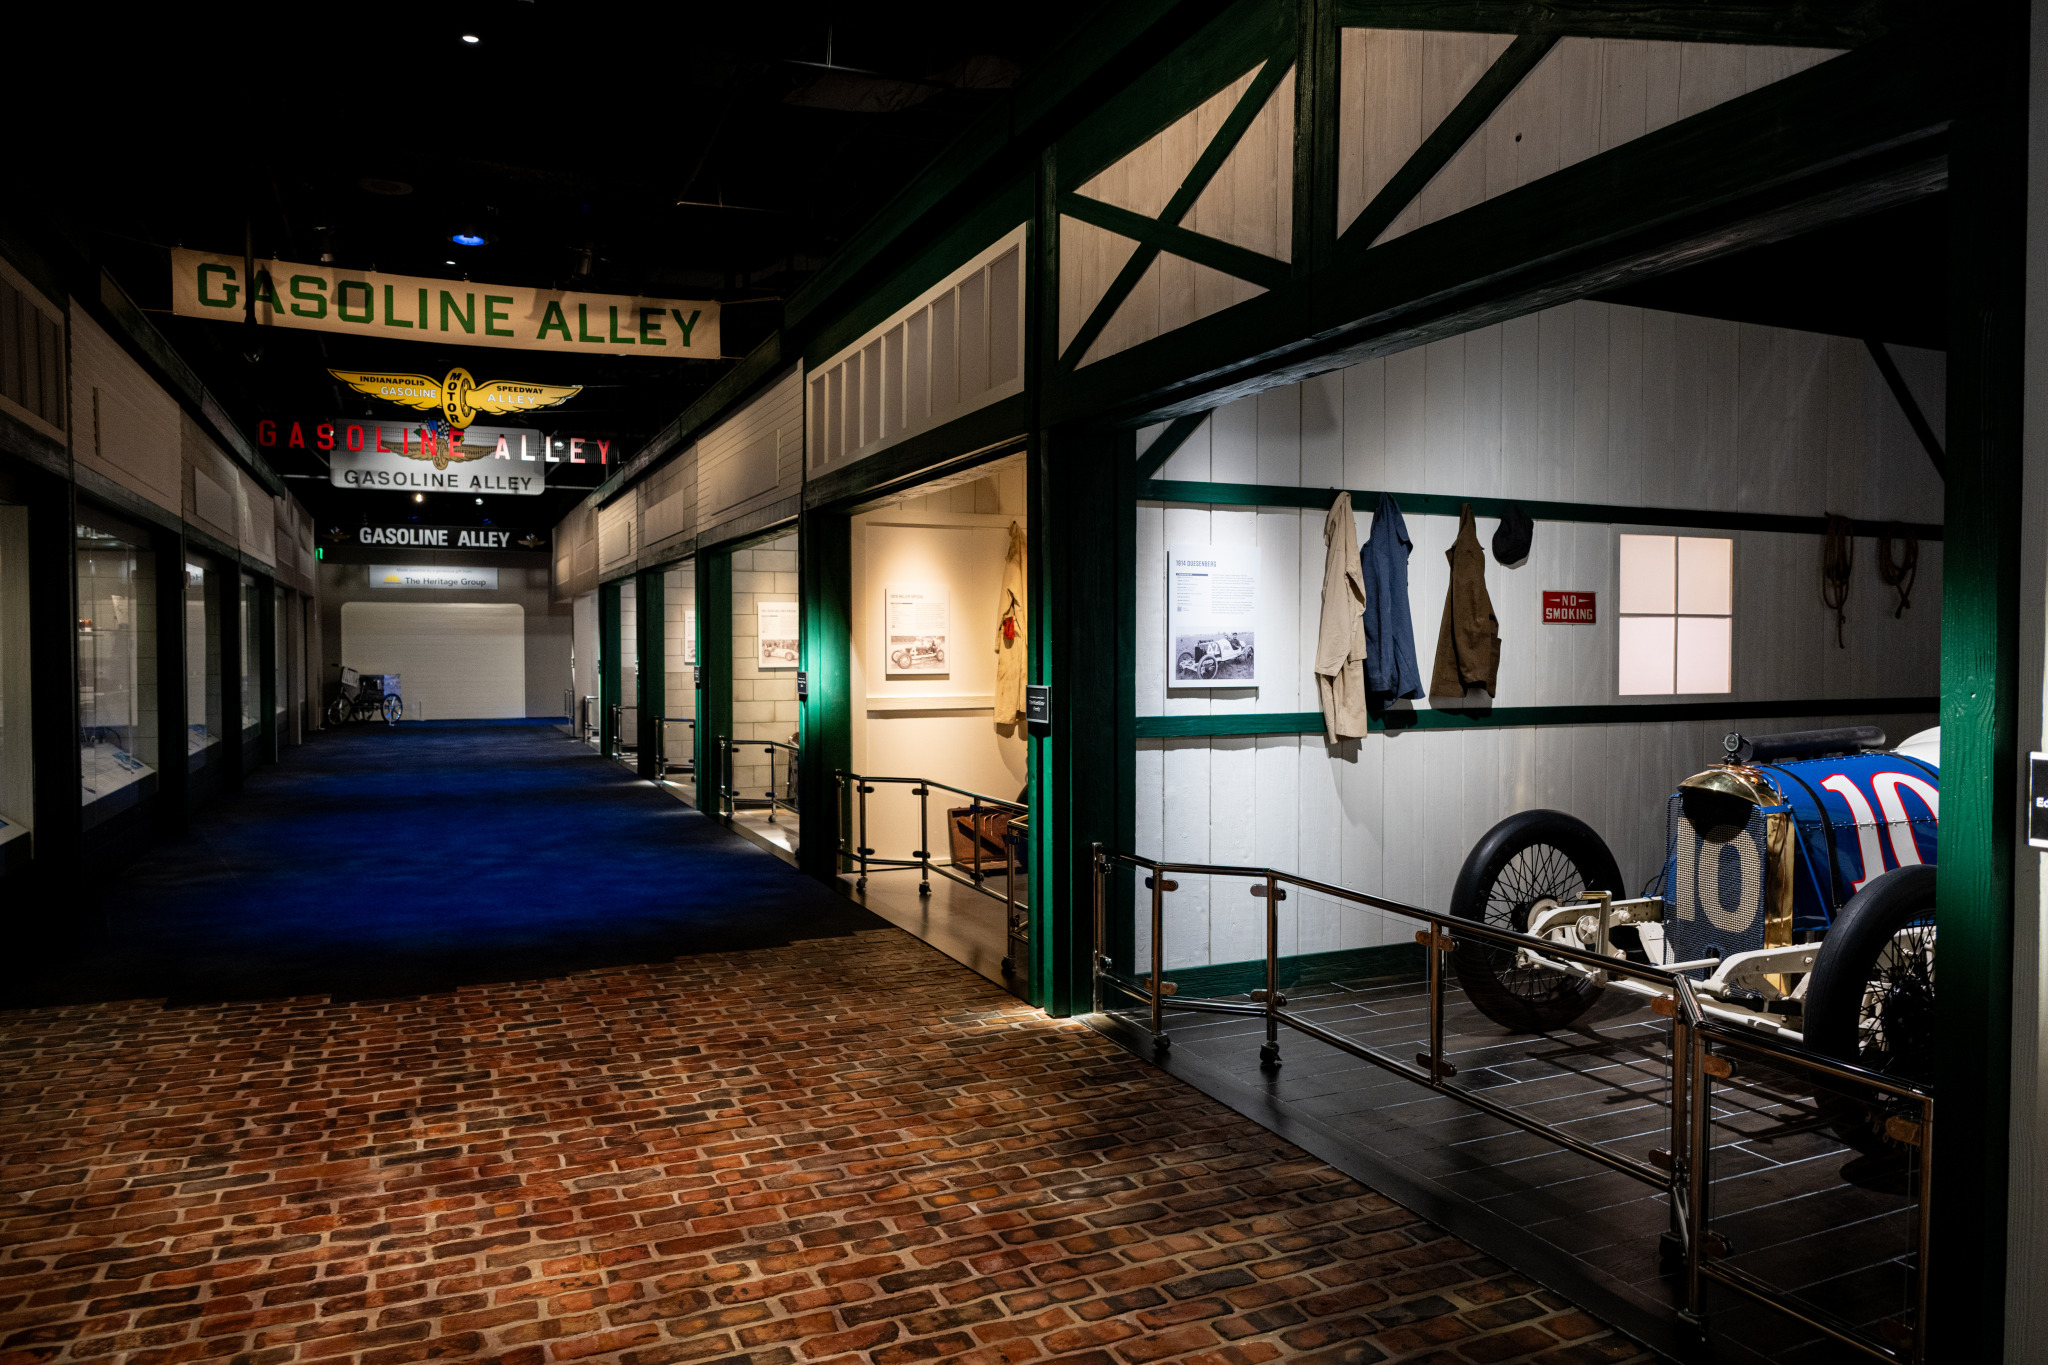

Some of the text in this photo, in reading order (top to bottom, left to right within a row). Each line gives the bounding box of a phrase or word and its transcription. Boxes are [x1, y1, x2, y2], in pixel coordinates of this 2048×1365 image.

[197, 262, 701, 348] GASOLINE ALLEY
[359, 375, 544, 395] INDIANAPOLIS SPEEDWAY
[380, 386, 536, 405] GASOLINE ALLEY
[447, 372, 461, 424] MOTOR
[258, 419, 611, 464] GASOLINE ALLEY
[344, 470, 533, 491] GASOLINE ALLEY
[359, 527, 510, 548] GASOLINE ALLEY
[405, 577, 487, 587] The Heritage Group
[1562, 595, 1577, 606] NO
[1545, 608, 1593, 620] SMOKING
[1820, 771, 1940, 893] 10
[1676, 816, 1762, 932] 10
